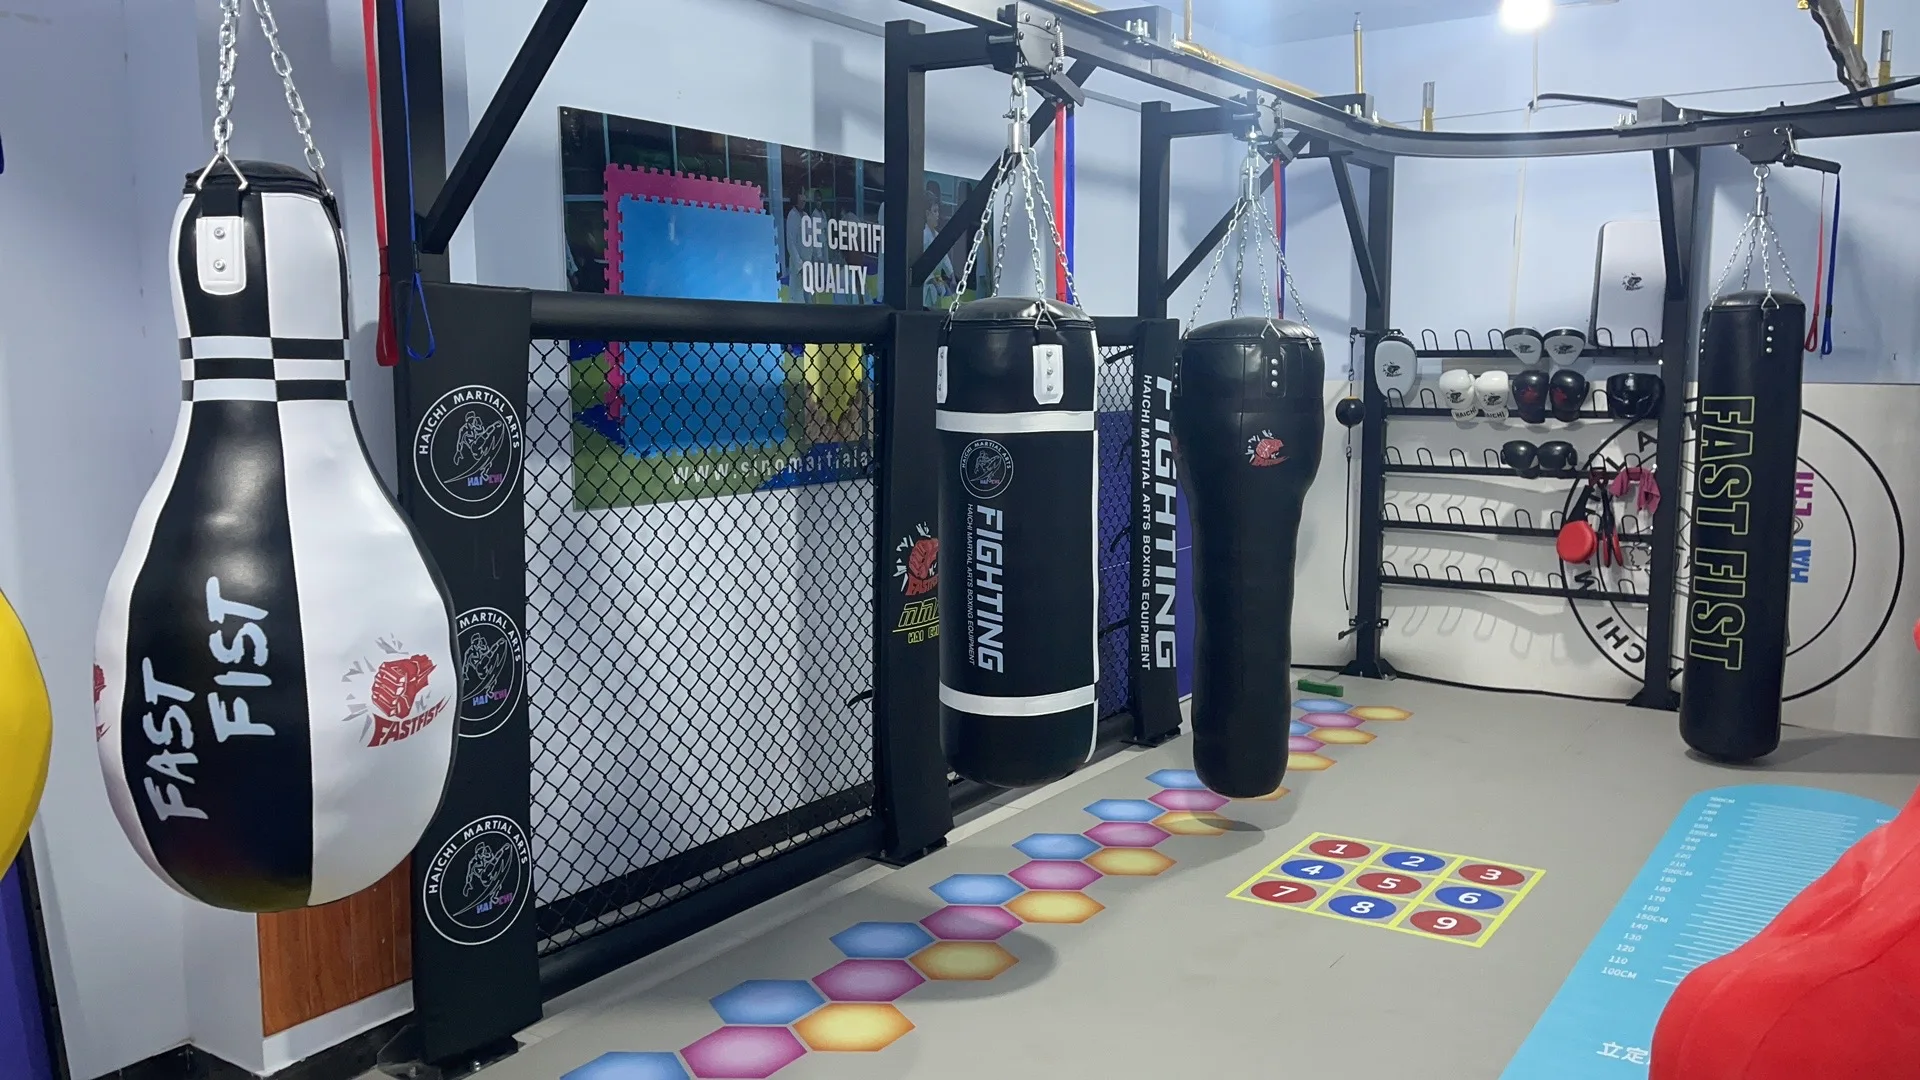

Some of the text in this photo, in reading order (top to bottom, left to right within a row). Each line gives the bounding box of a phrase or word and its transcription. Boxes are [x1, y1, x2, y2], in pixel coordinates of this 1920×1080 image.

[801, 215, 822, 248] CE
[802, 260, 868, 295] QUALITY
[1455, 406, 1477, 418] HAICHI
[419, 390, 520, 455] HAICHI MARTIAL ARTS
[974, 441, 1002, 452] MARTIAL
[1002, 452, 1011, 469] ARTS
[1140, 374, 1152, 670] HAICHI MARTIAL ARTS BOXING EQUIPMENT
[1155, 376, 1177, 668] FIGHTING
[1689, 395, 1755, 671] FAST FIST
[1790, 539, 1812, 583] HAI
[966, 503, 975, 666] HAICHI MARTIAL ARTS BOXING EQUIPMENT
[976, 504, 1004, 674] FIGHTING
[459, 612, 521, 662] MARTIAL ARTS
[206, 576, 276, 743] FIST
[367, 695, 446, 748] FASTFIST
[141, 656, 209, 822] FAST
[1328, 843, 1348, 855] 1
[428, 820, 528, 894] HAICHI MARTIAL ARTS
[1401, 856, 1425, 867] 2
[1300, 865, 1323, 876] 4
[1479, 868, 1502, 881] 3
[1376, 877, 1401, 889] 5
[1272, 886, 1298, 898] 7
[1457, 892, 1482, 904] 6
[1647, 894, 1665, 903] 170
[1350, 901, 1375, 914] 8
[1432, 916, 1458, 930] 9
[1636, 912, 1669, 924] 150CM
[1631, 922, 1648, 930] 140
[1623, 932, 1642, 941] 130
[1615, 943, 1635, 953] 120
[1608, 955, 1628, 965] 110
[1601, 966, 1637, 979] 100CM
[1596, 1041, 1650, 1065] 立定
